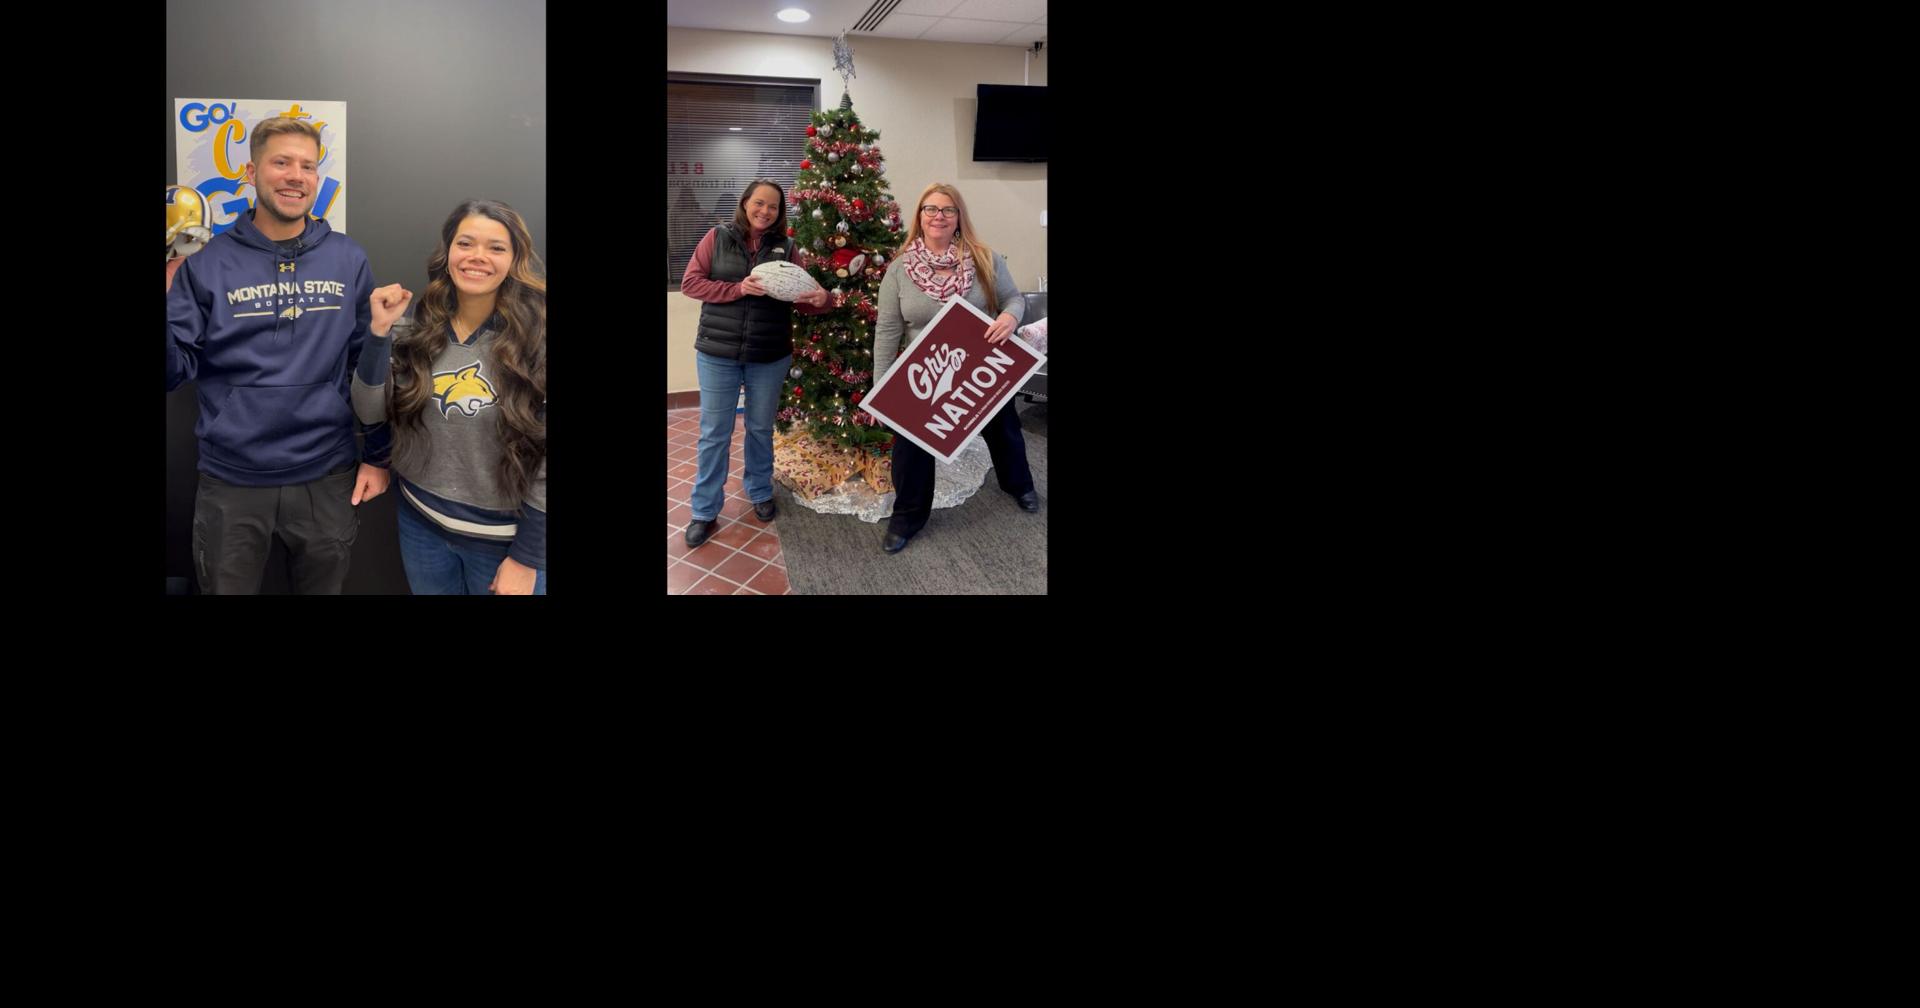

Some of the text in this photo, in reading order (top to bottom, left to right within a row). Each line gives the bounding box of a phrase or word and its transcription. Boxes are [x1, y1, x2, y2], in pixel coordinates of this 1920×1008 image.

[180, 102, 237, 132] GO!
[227, 280, 346, 305] MONTANA STATE
[254, 297, 326, 309] BOBCATS
[907, 343, 967, 405] Griz
[924, 347, 1016, 440] NATION
